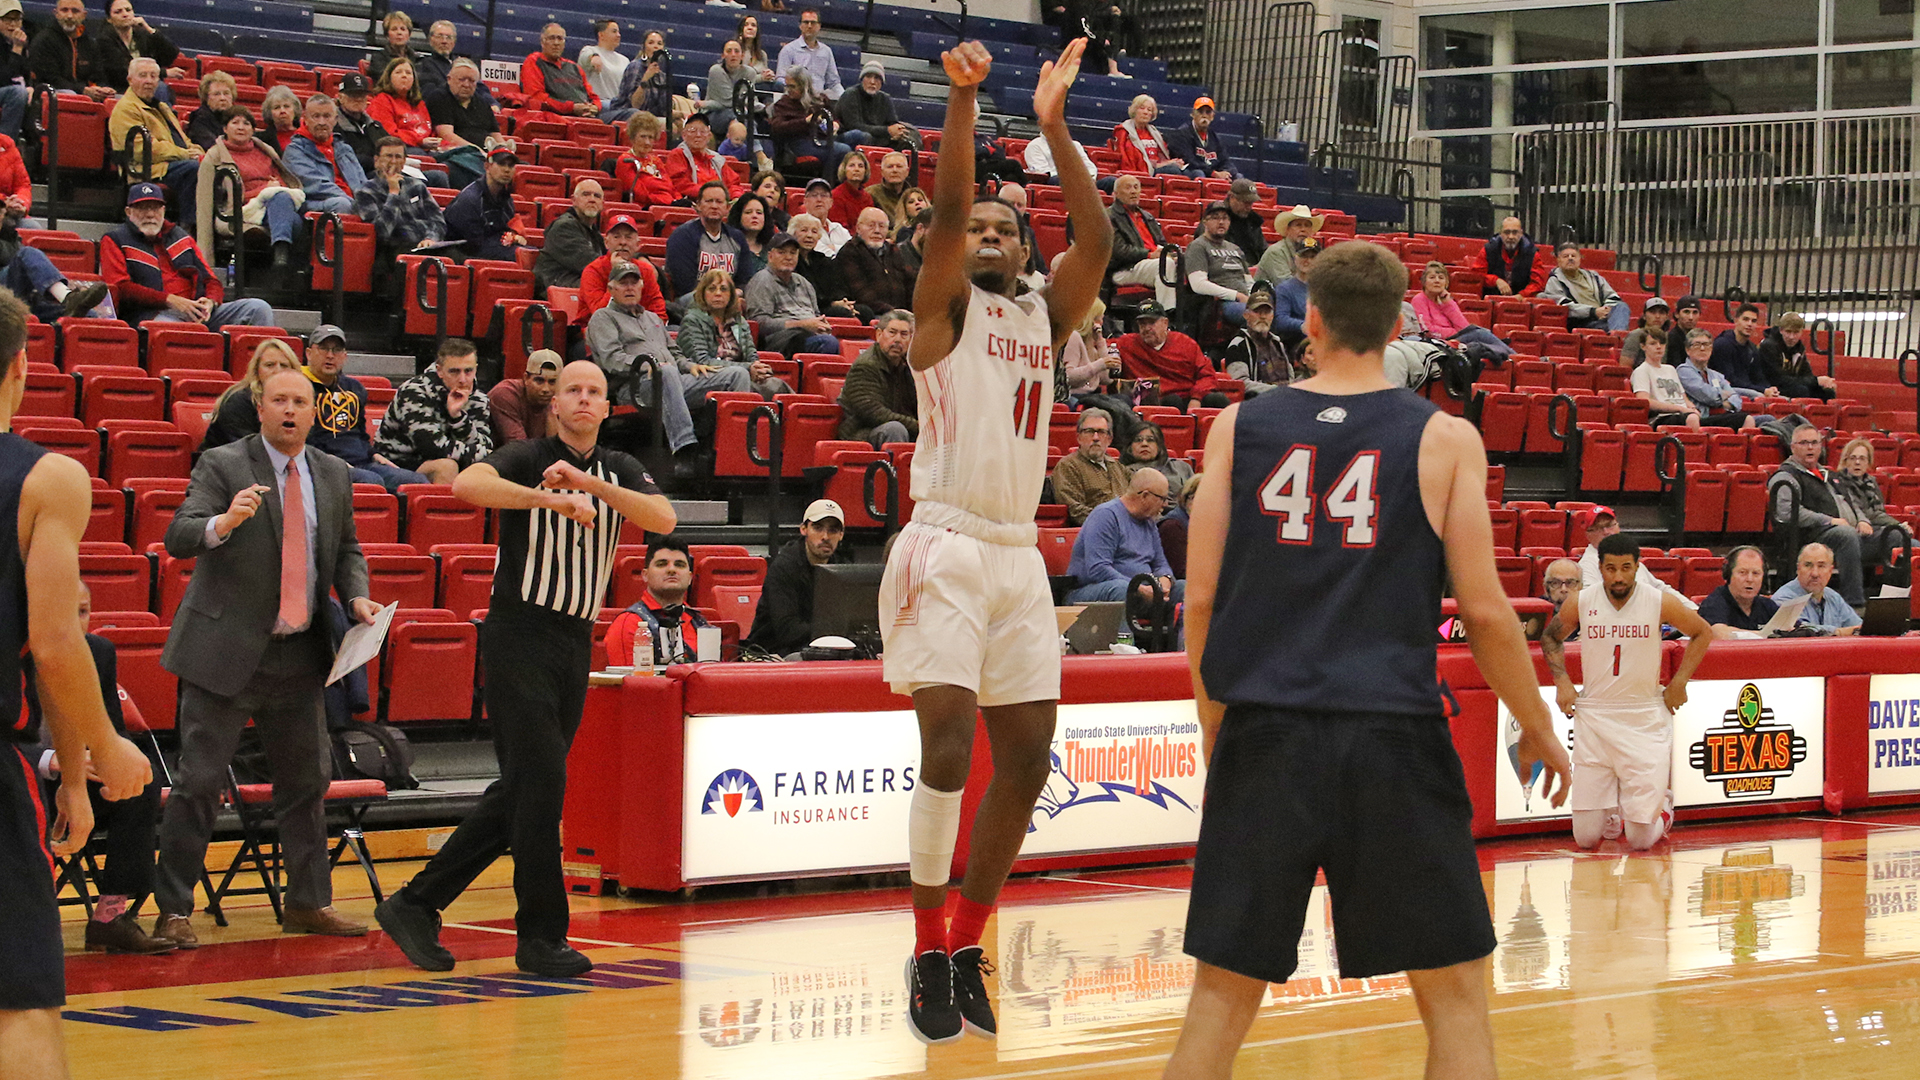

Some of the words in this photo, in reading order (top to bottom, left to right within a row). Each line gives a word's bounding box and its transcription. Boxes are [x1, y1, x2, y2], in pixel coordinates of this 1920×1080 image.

[484, 68, 517, 81] SECTION
[698, 251, 735, 273] PACK
[1013, 378, 1042, 440] 11
[1256, 443, 1381, 549] 44
[1587, 625, 1650, 639] CSU-PUEBLO
[1613, 645, 1621, 676] 1
[1869, 699, 1920, 730] DAVE
[1065, 727, 1103, 739] Colorado
[1104, 725, 1126, 738] State
[1127, 722, 1198, 737] University-Pueblo
[1065, 737, 1196, 795] ThunderWolves
[1707, 732, 1790, 773] TEXAS
[774, 767, 915, 797] FARMERS
[1726, 777, 1774, 792] ROADHOUSE
[773, 805, 869, 825] INSURANCE
